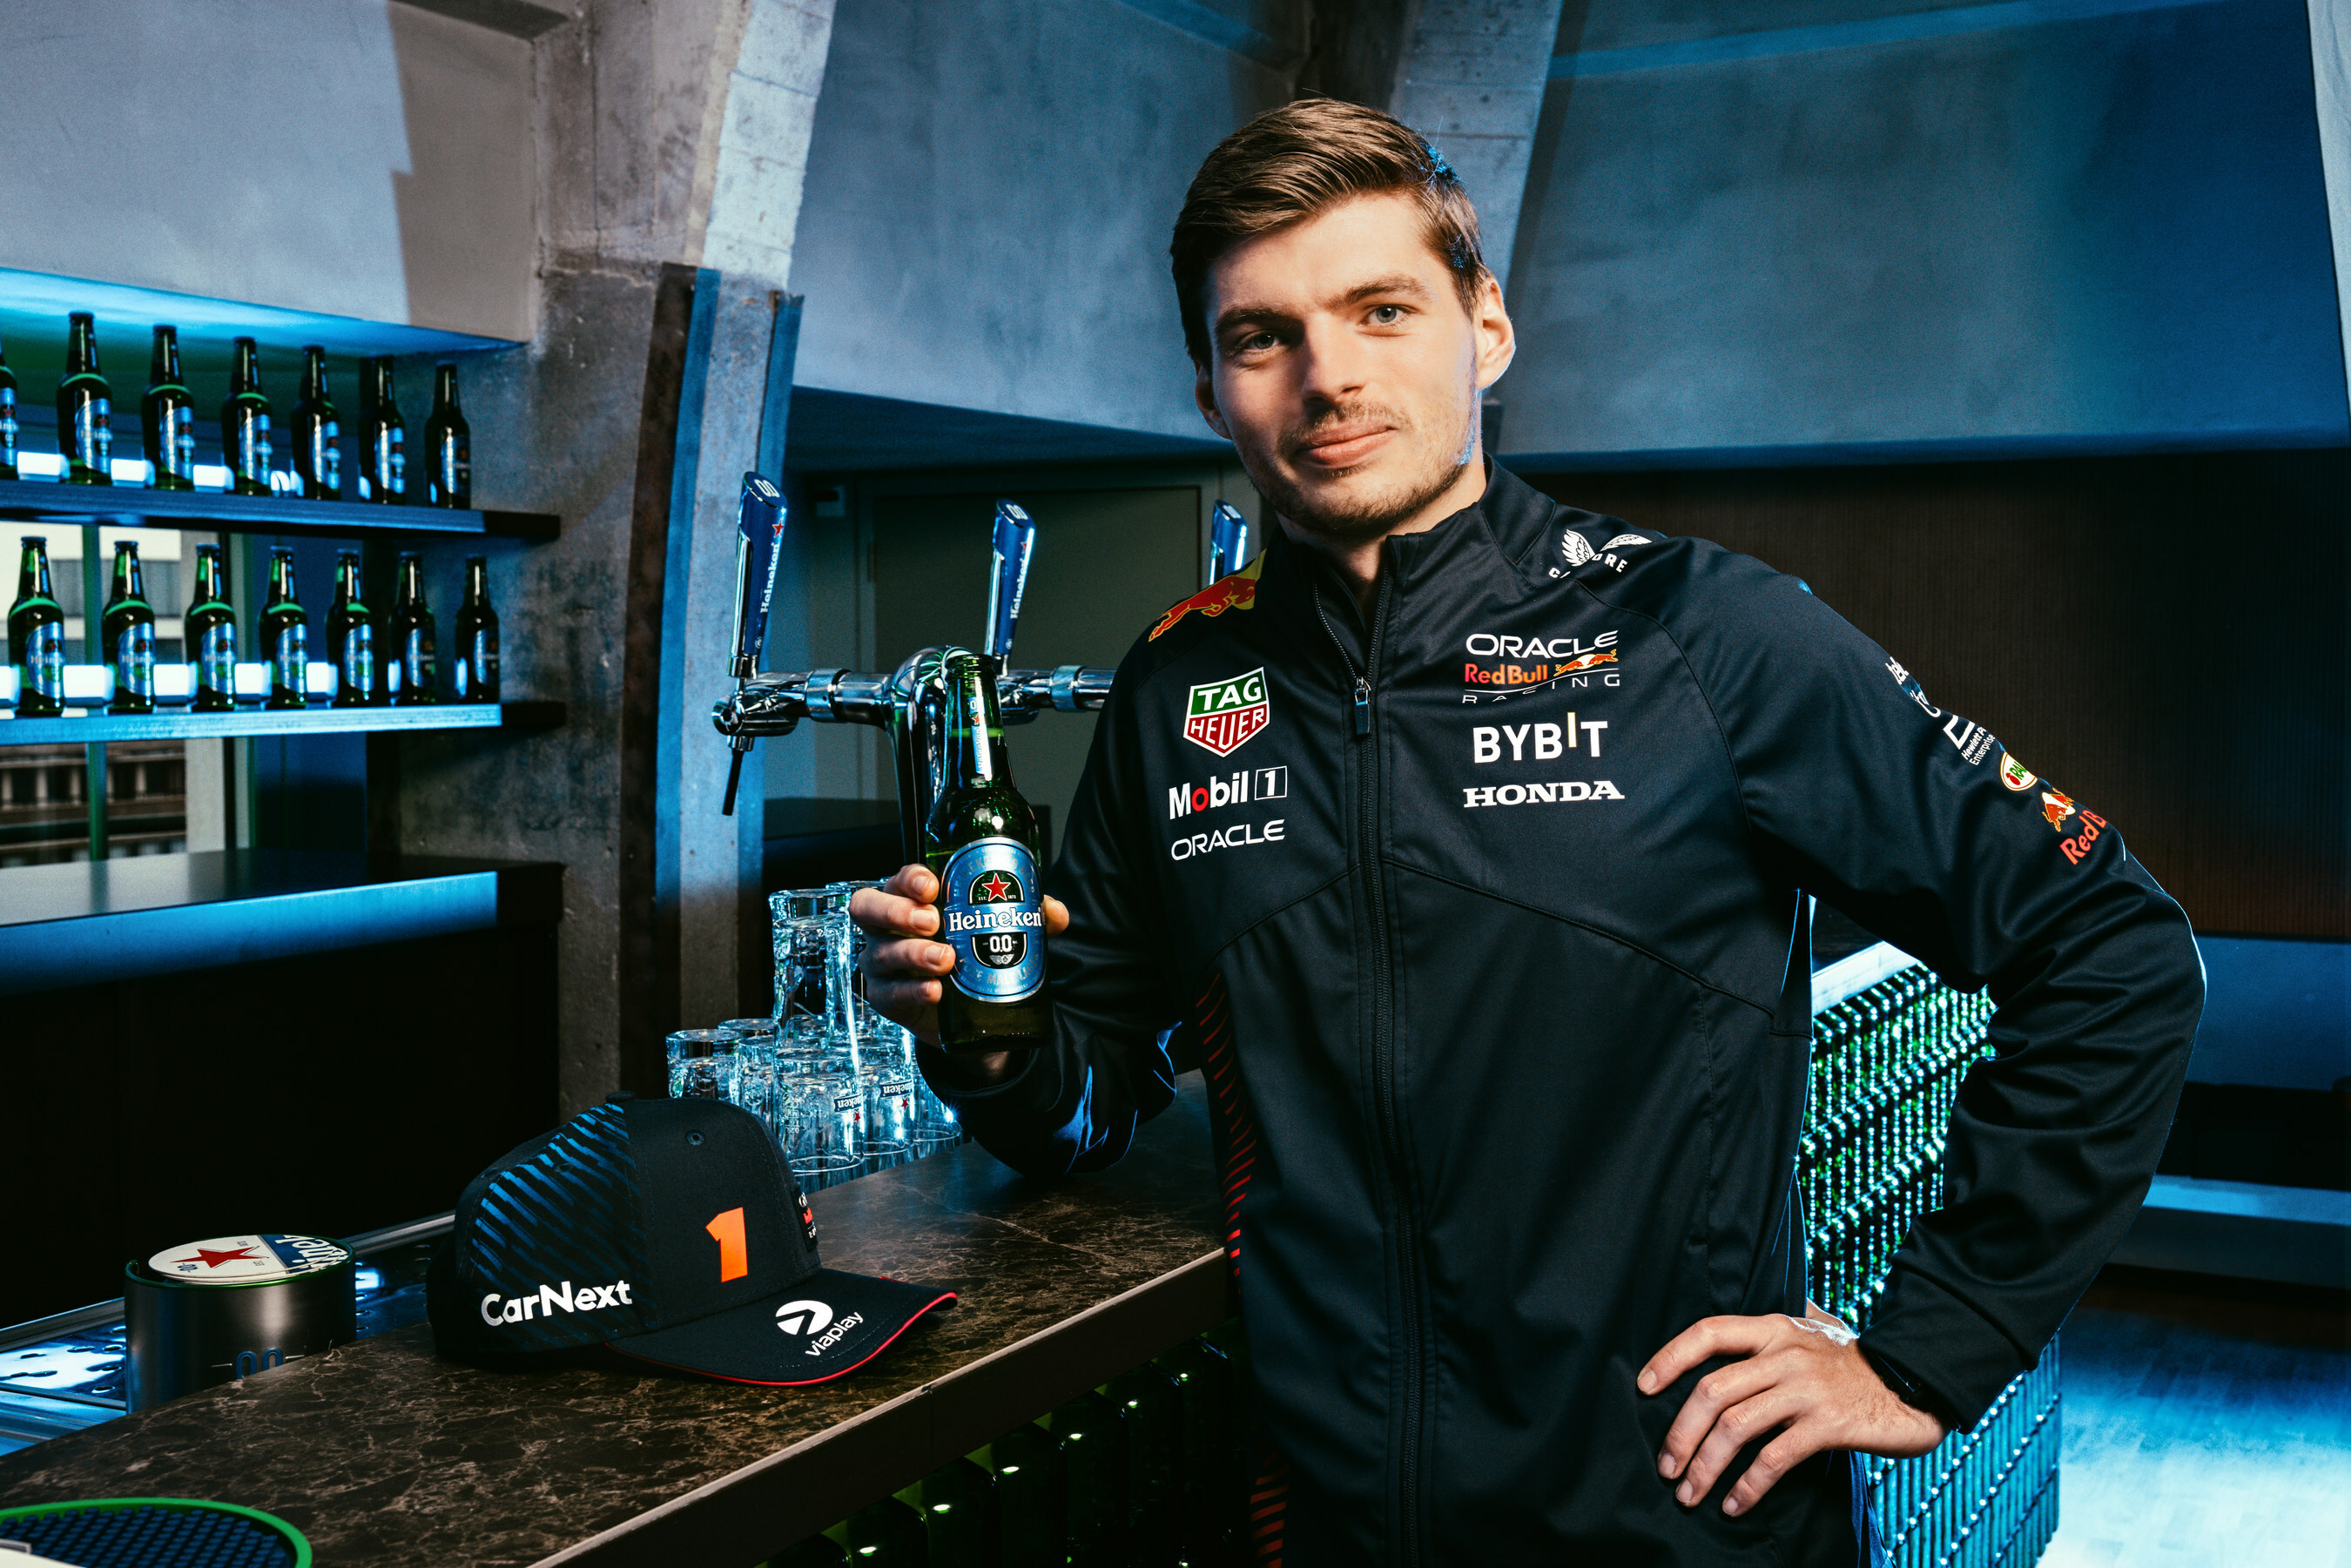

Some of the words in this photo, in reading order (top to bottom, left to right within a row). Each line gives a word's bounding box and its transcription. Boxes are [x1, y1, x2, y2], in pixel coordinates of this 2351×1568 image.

[760, 542, 781, 613] Heineken
[1465, 629, 1619, 659] ORACLE
[1197, 676, 1263, 711] TAG
[1462, 673, 1620, 704] RACING
[1190, 707, 1265, 750] HEUER
[1472, 711, 1609, 764] BYBIT
[1961, 731, 1984, 761] Hewlett
[1969, 734, 1996, 765] Enterprise
[1169, 771, 1249, 820] Mobil
[1264, 769, 1277, 797] 1
[1463, 780, 1626, 808] HONDA
[1170, 818, 1286, 861] ORACLE
[948, 906, 1043, 932] Heineken
[989, 934, 1014, 953] 0.0
[705, 1207, 749, 1283] 1
[481, 1280, 633, 1327] CarNext
[805, 1311, 864, 1357] viaplay
